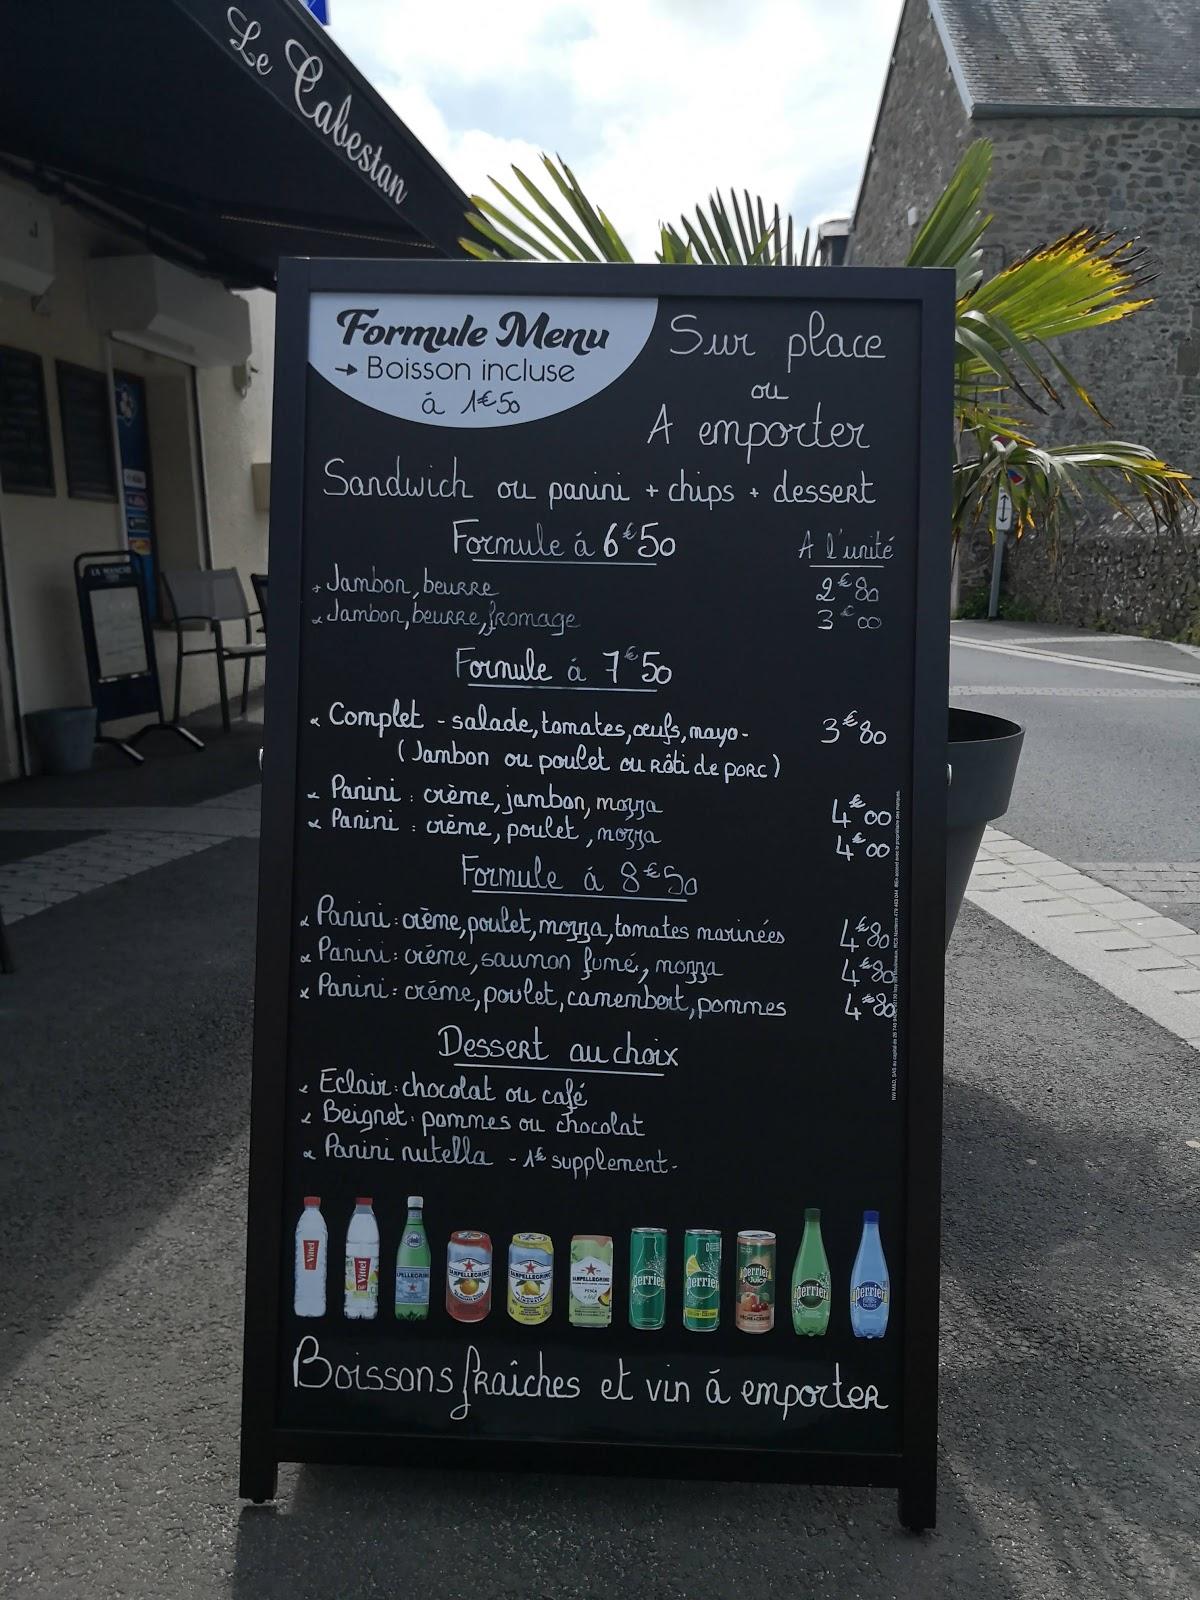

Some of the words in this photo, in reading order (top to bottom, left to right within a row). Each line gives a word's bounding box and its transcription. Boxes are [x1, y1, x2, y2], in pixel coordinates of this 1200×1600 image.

[227, 6, 273, 76] Le
[284, 39, 409, 205] Cabestan
[337, 308, 488, 353] Formule
[496, 311, 610, 355] Menu
[670, 314, 756, 355] Sur
[787, 310, 886, 373] place
[367, 355, 471, 380] Boisson
[482, 358, 576, 382] incluse
[751, 381, 789, 400] ou
[647, 403, 673, 445] A
[699, 401, 870, 464] emporter
[323, 455, 474, 498] Sandwich
[497, 480, 536, 499] ou
[549, 471, 630, 510] panini
[668, 468, 735, 510] chips
[773, 468, 876, 504] dessert
[452, 518, 564, 556] Formule
[456, 647, 553, 681] Formule
[329, 698, 424, 739] Complet
[504, 751, 533, 769] ou
[538, 742, 611, 775] poulet
[619, 757, 647, 774] ou
[694, 753, 720, 777] de
[461, 853, 564, 889] Formule
[696, 918, 786, 945] marinées
[437, 1023, 549, 1062] Dessert
[612, 1029, 679, 1068] choix
[401, 1070, 497, 1102] chocolat
[505, 1085, 537, 1104] ou
[542, 1077, 588, 1115] café
[518, 1114, 545, 1134] ou
[555, 1108, 646, 1138] chocolat
[325, 1131, 394, 1162] Panini
[401, 1134, 494, 1167] nutella
[292, 1335, 454, 1394] Boissons
[450, 1344, 581, 1421] fraîches
[600, 1357, 634, 1402] et
[645, 1363, 690, 1403] vin
[740, 1360, 890, 1421] emporter
